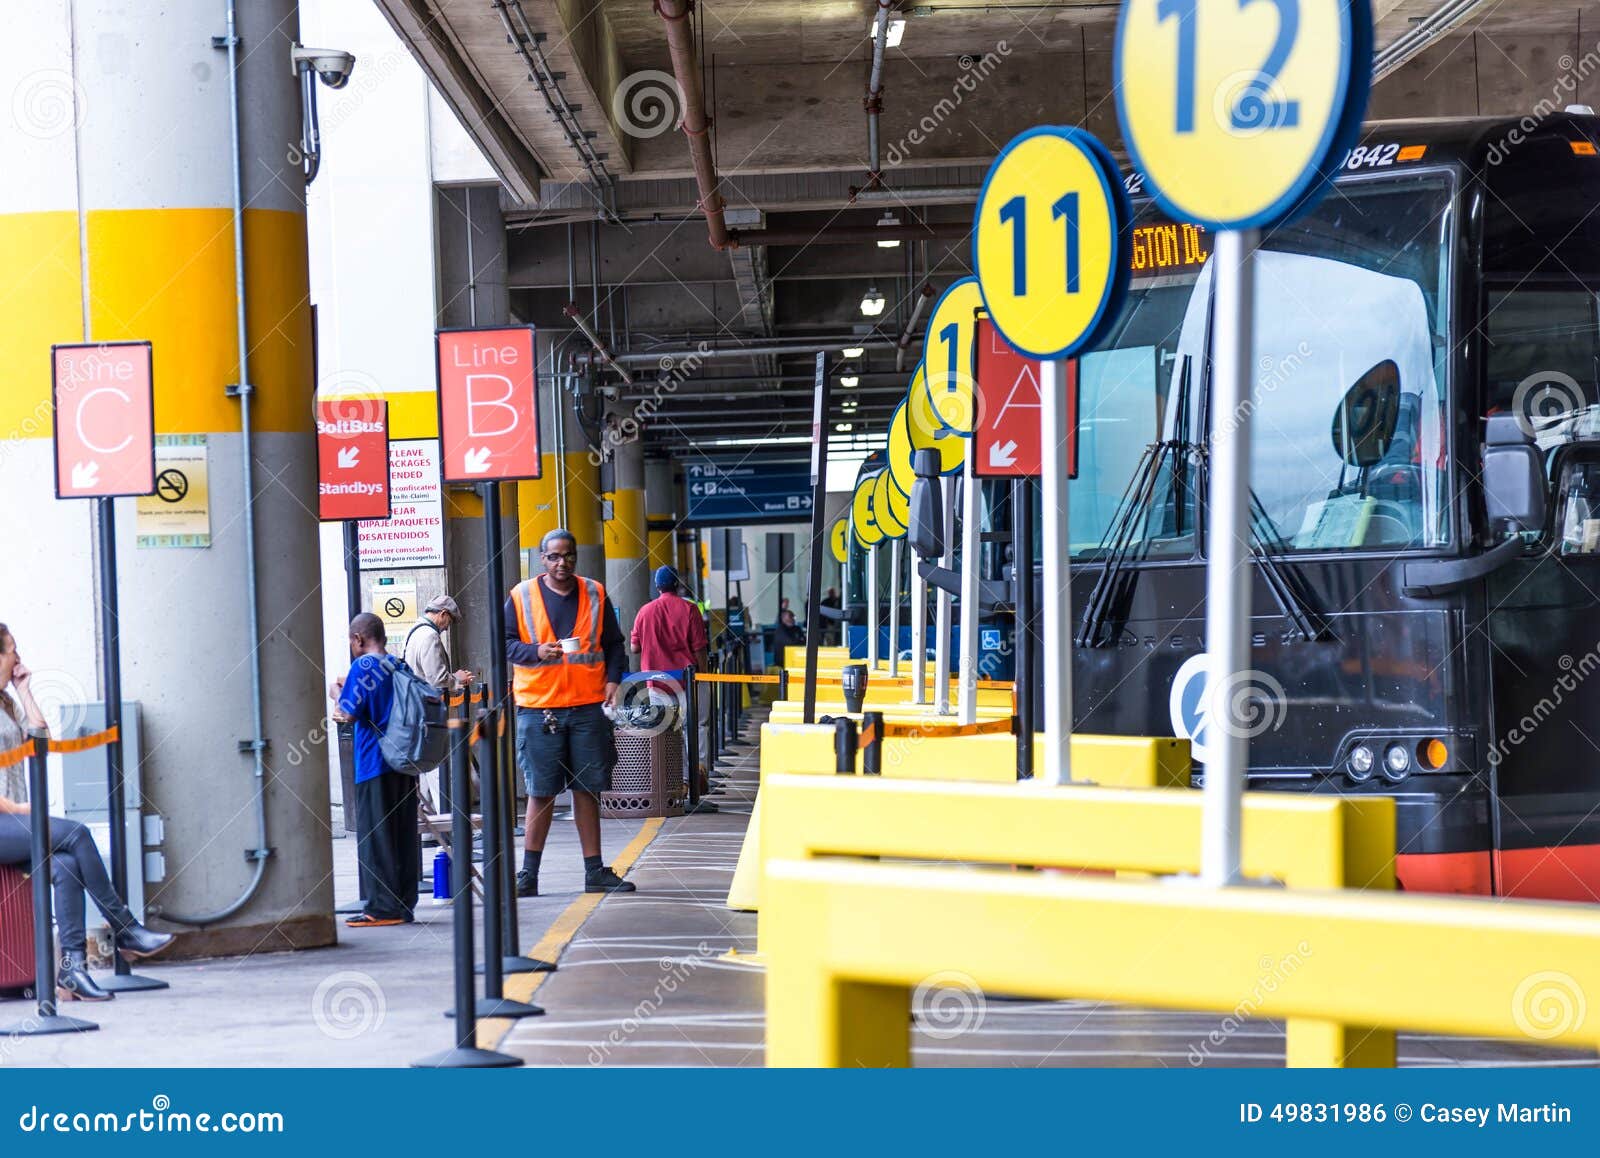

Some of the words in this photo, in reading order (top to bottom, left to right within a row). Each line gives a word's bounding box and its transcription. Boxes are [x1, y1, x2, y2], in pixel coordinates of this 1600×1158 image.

[1156, 0, 1301, 134] 12
[1339, 143, 1400, 170] 842
[999, 191, 1081, 297] 11
[1131, 225, 1180, 269] GTON
[1182, 223, 1208, 264] DC
[454, 343, 519, 367] Line
[465, 373, 519, 438] B
[991, 364, 1043, 430] A
[76, 387, 134, 454] C
[395, 448, 424, 458] LEAVE
[319, 482, 384, 496] Standbys
[395, 484, 437, 492] confiscated
[358, 517, 440, 528] UIPAJE/PAQUETES
[391, 507, 416, 515] EJAR
[358, 531, 430, 542] DESATENDIDOS
